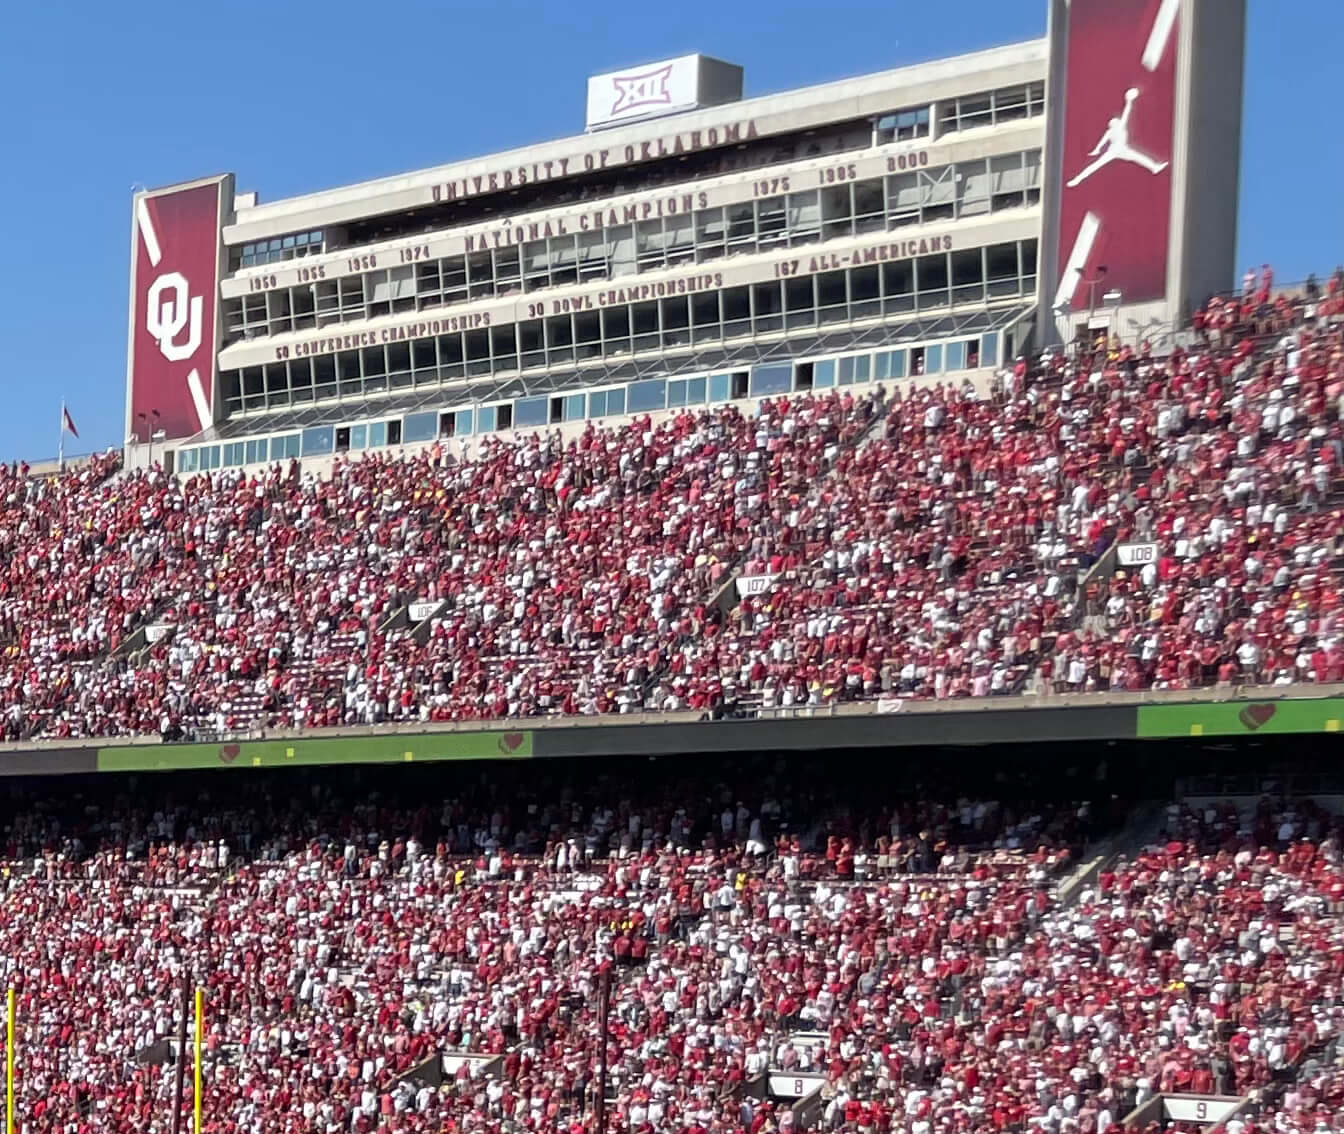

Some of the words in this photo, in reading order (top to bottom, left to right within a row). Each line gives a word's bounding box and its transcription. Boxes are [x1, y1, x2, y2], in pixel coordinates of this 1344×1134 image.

[432, 158, 571, 202] UNIVERSITY
[584, 150, 610, 170] OF
[625, 120, 758, 162] OKLAHOMA
[400, 245, 431, 264] 1974
[465, 219, 567, 252] NATIONAL
[580, 192, 709, 230] CHAMPIONS
[888, 151, 928, 172] 2000
[147, 272, 204, 361] OU
[295, 330, 376, 356] CONFERENCE
[382, 312, 491, 342] CHAMPIONSHIPS
[553, 294, 593, 315] BOWL
[598, 273, 723, 307] CHAMPIONSHIPS
[809, 235, 953, 272] ALL-AMERICANS
[794, 1080, 803, 1095] 8
[1197, 1102, 1208, 1120] 9
